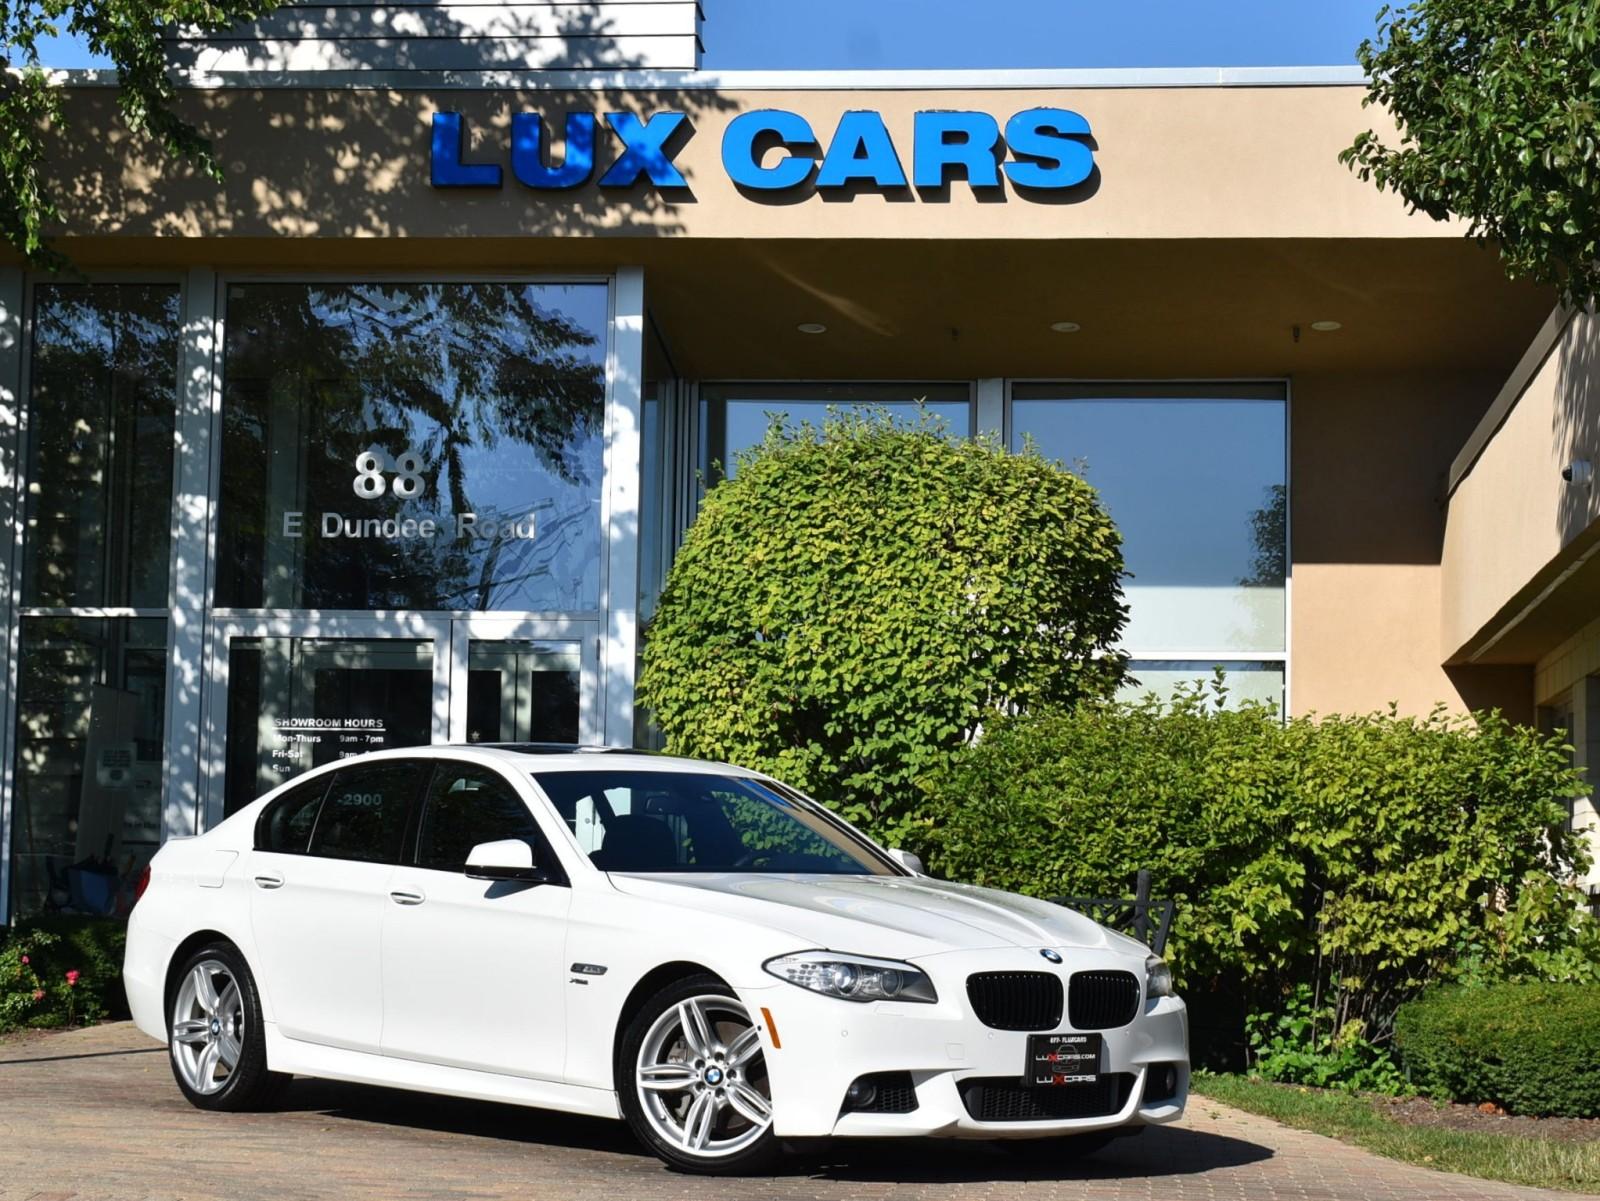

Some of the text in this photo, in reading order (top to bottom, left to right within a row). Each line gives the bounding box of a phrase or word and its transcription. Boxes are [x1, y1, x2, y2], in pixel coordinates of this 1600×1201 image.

[430, 107, 1096, 192] LUX CARS
[352, 450, 426, 500] 88
[282, 511, 536, 540] E Dundee Road
[274, 717, 384, 729] SHOWROOM HOURS
[272, 733, 322, 744] Mon-Thurs
[339, 734, 358, 744] 9am
[364, 734, 384, 745] 7pm
[272, 750, 304, 759] Fri-Sat
[272, 764, 291, 774] Sun
[1036, 1074, 1097, 1085] LUXCARS
